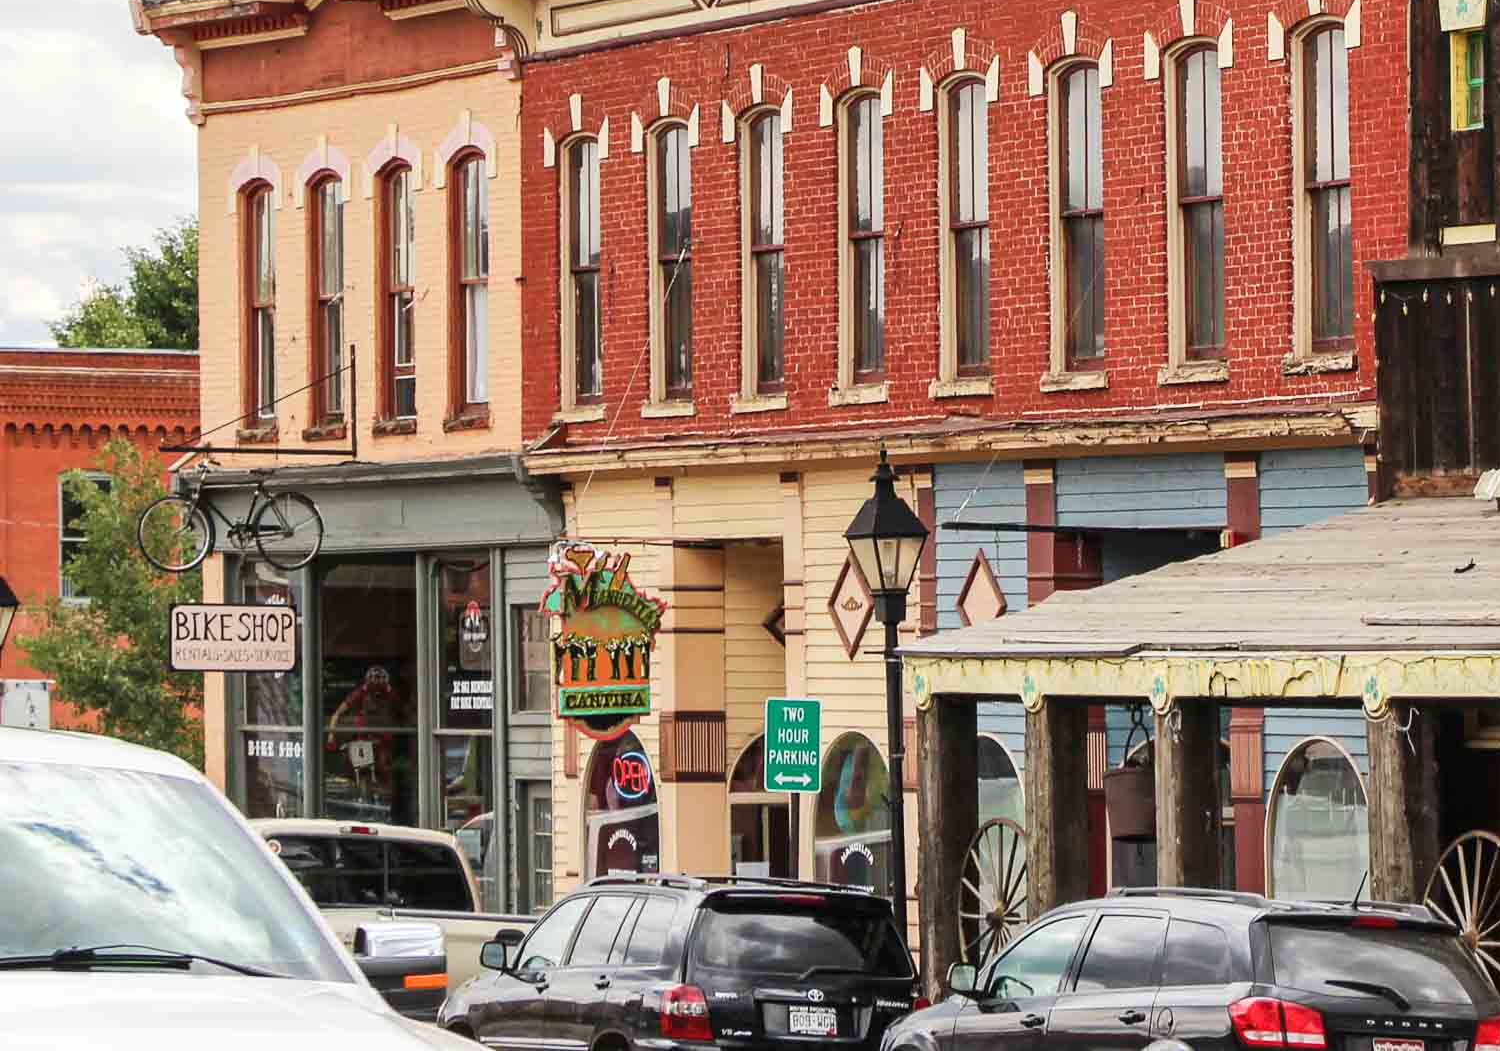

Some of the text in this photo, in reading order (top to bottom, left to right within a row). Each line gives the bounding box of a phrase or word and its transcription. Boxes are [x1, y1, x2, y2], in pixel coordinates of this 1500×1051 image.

[175, 611, 293, 643] BIKE SHOP
[565, 691, 645, 710] CANTINA
[783, 707, 805, 723] TWO
[778, 729, 809, 744] HOUR
[247, 739, 275, 757] BIKE
[768, 749, 817, 766] PARKING
[613, 756, 650, 794] OPEN
